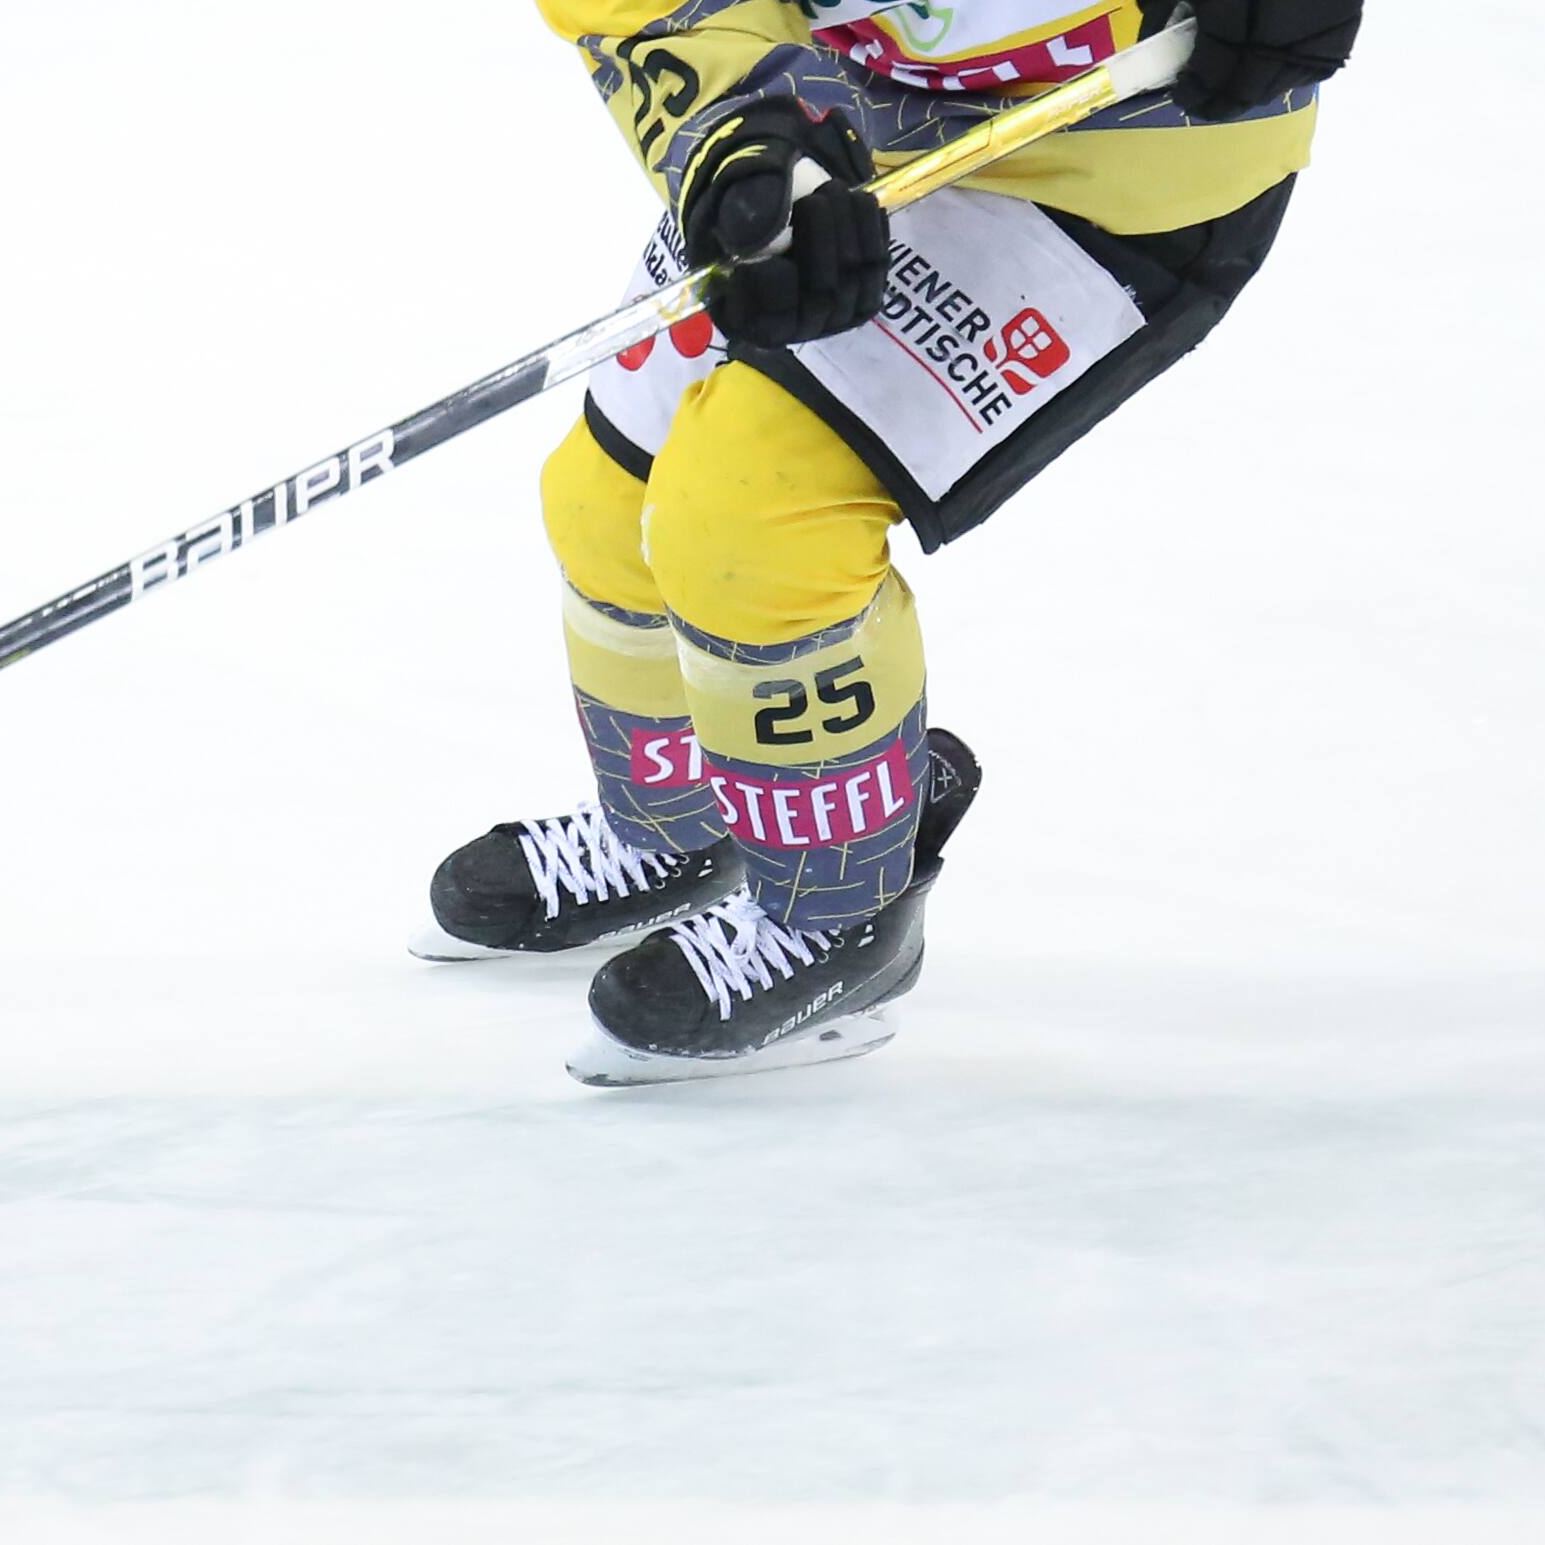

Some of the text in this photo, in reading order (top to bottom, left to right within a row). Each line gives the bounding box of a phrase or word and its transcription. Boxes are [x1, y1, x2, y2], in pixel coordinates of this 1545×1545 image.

[881, 282, 1012, 425] DTISCHE
[753, 655, 875, 745] 25
[710, 761, 905, 845] STEFFL
